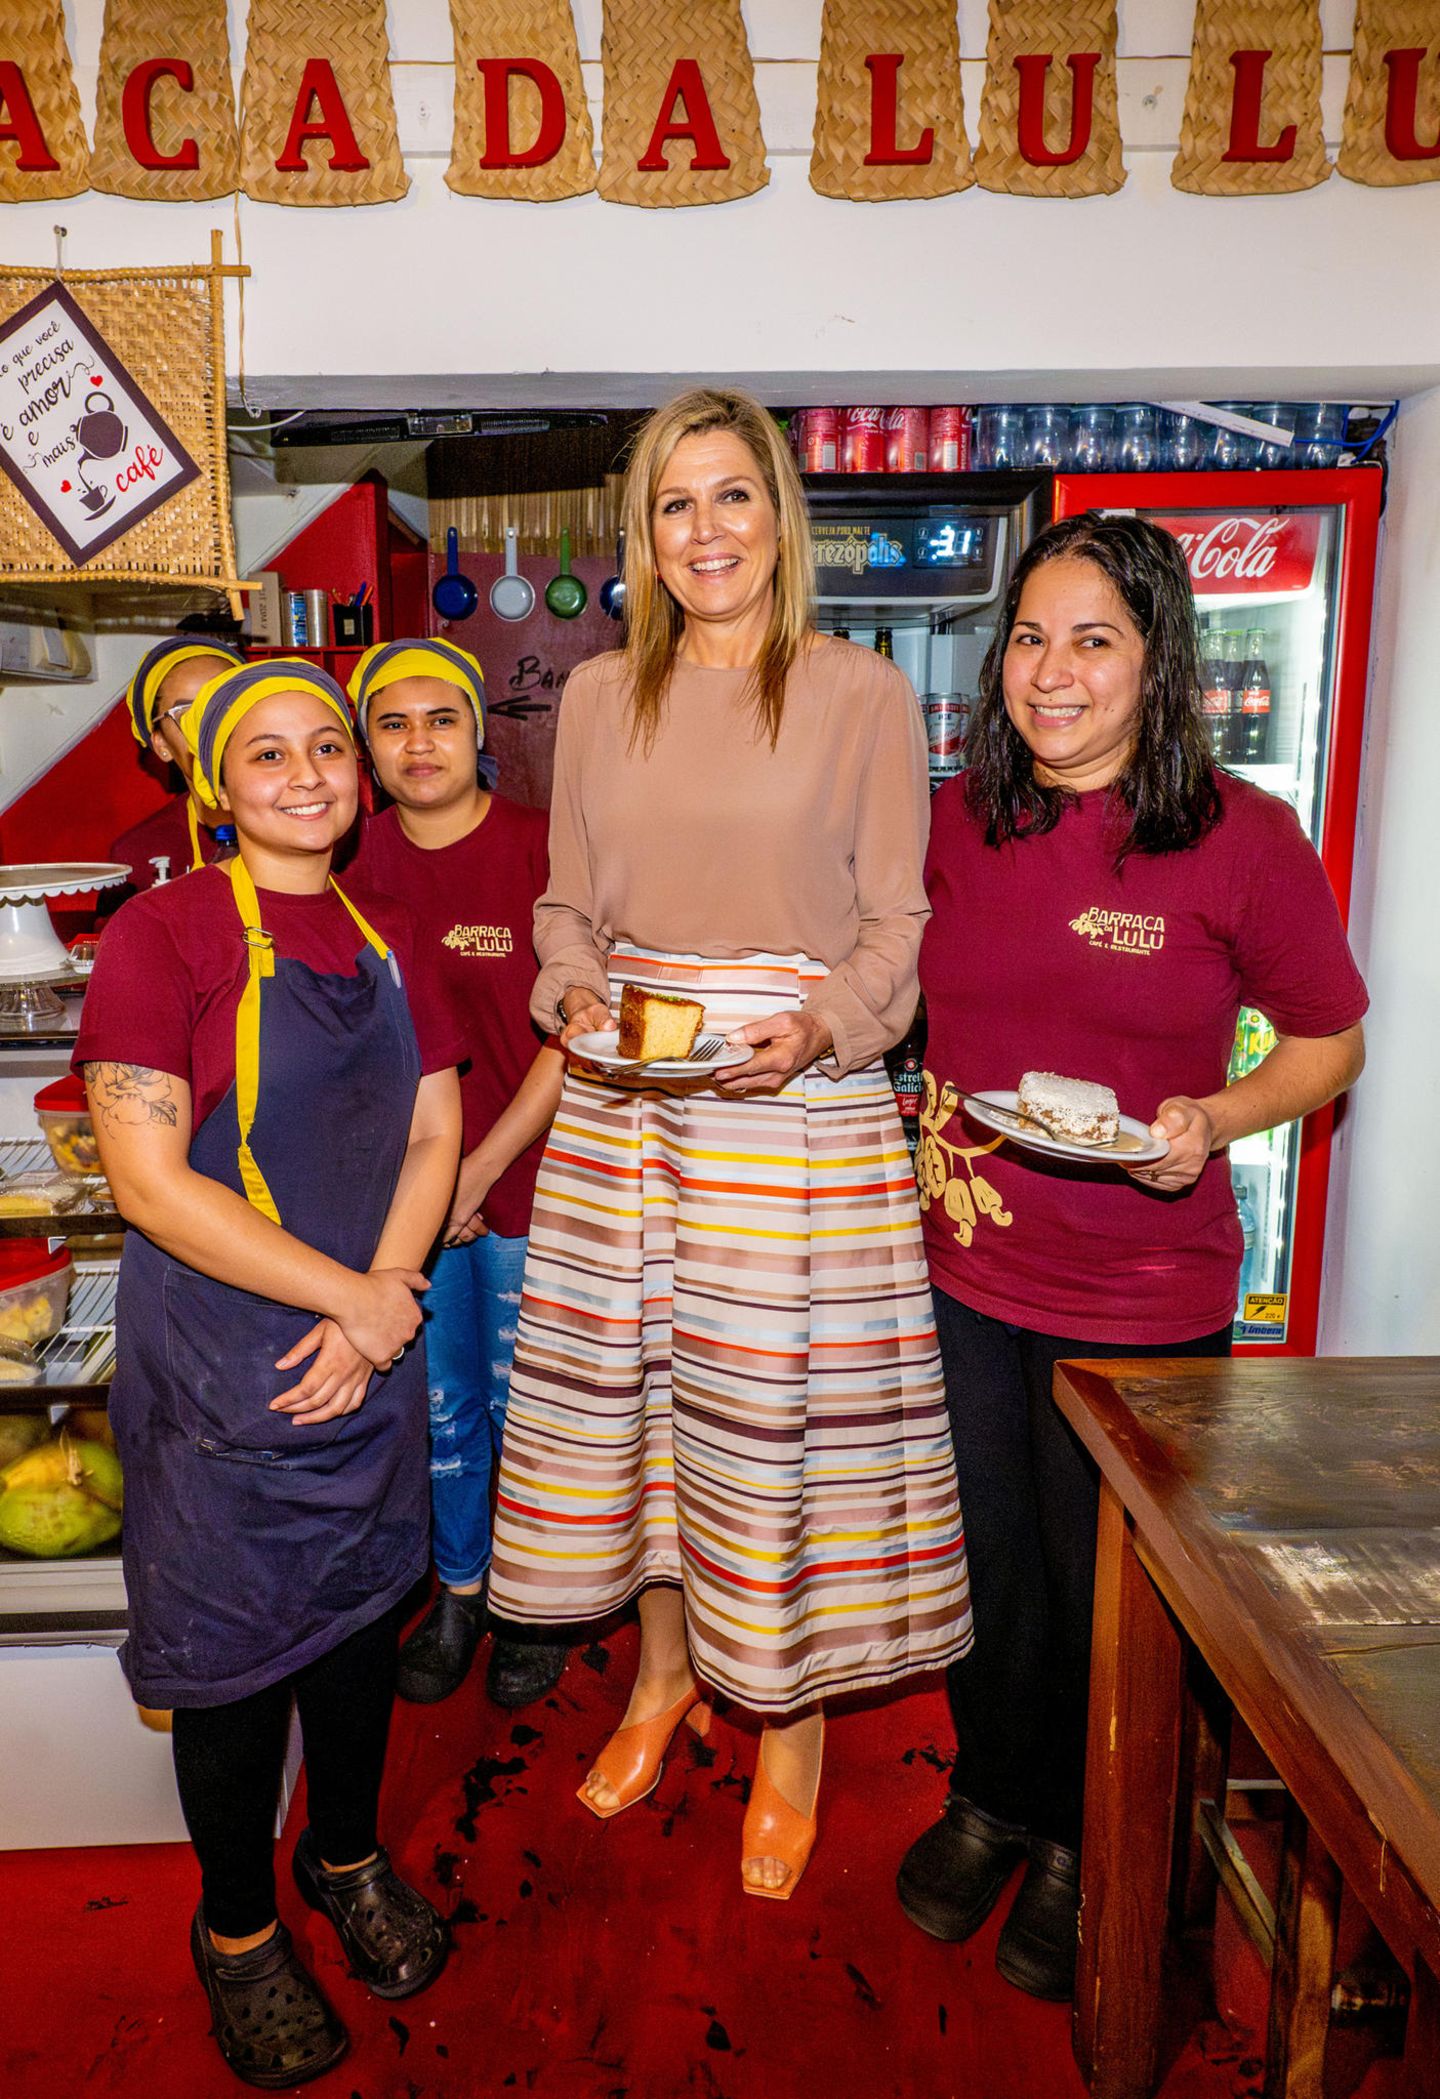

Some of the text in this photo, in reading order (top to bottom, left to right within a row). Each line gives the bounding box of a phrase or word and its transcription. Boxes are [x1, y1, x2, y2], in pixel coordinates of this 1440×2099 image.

[477, 57, 729, 171] DA
[12, 344, 34, 367] que
[35, 319, 62, 346] você
[17, 337, 75, 395] precisa
[18, 371, 73, 428] amor
[27, 430, 39, 447] e
[42, 433, 77, 469] mais
[116, 443, 164, 493] café
[454, 924, 512, 939] BARRACA
[1087, 906, 1165, 932] BARRACA
[476, 937, 513, 952] LULU
[1113, 926, 1164, 950] LULU
